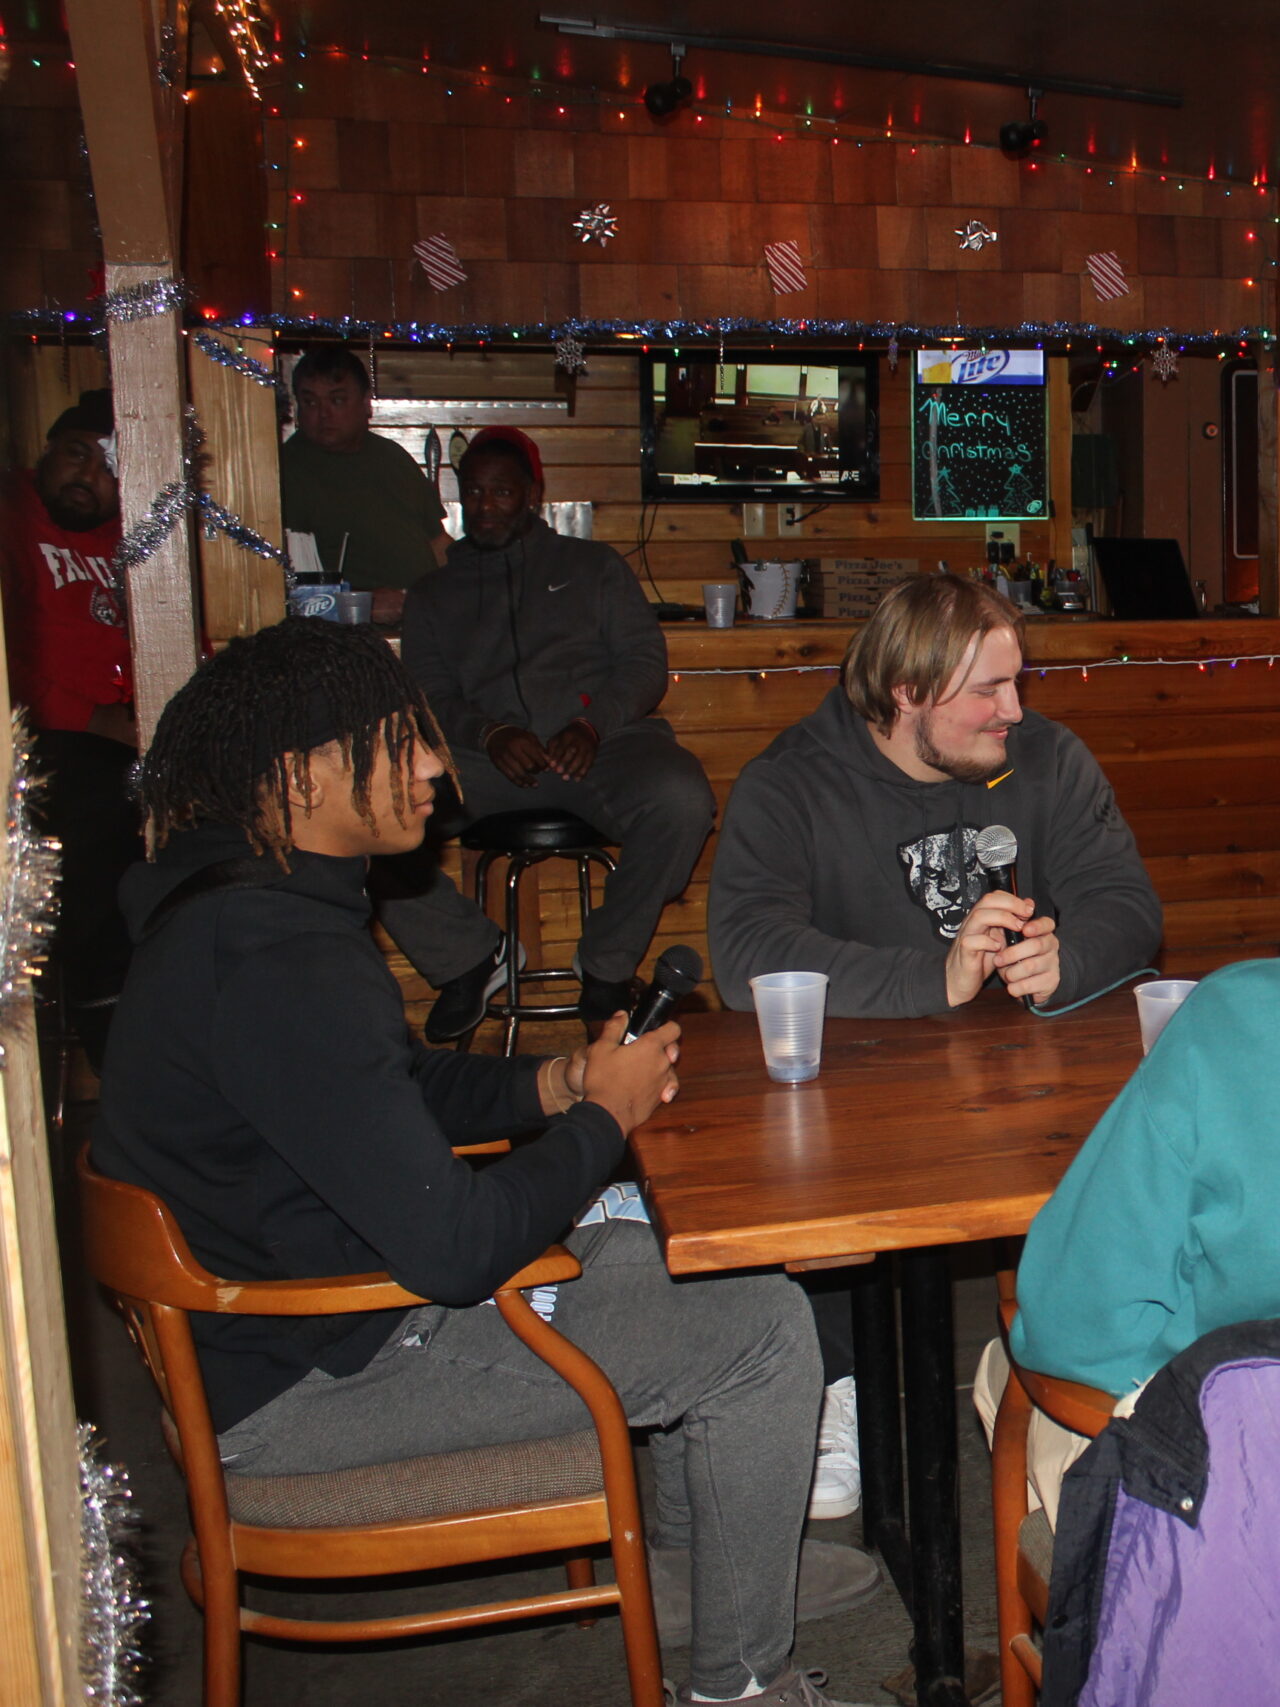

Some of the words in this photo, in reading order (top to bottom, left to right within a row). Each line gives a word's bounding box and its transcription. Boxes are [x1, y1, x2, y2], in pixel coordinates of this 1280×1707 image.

[957, 355, 1001, 383] Lite
[919, 398, 1011, 436] Merry
[835, 560, 867, 570] Pizza
[872, 559, 903, 570] Joe's
[838, 575, 870, 585] Pizza
[839, 592, 871, 602] Pizza
[304, 599, 330, 617] Lite
[839, 607, 870, 617] Pizza
